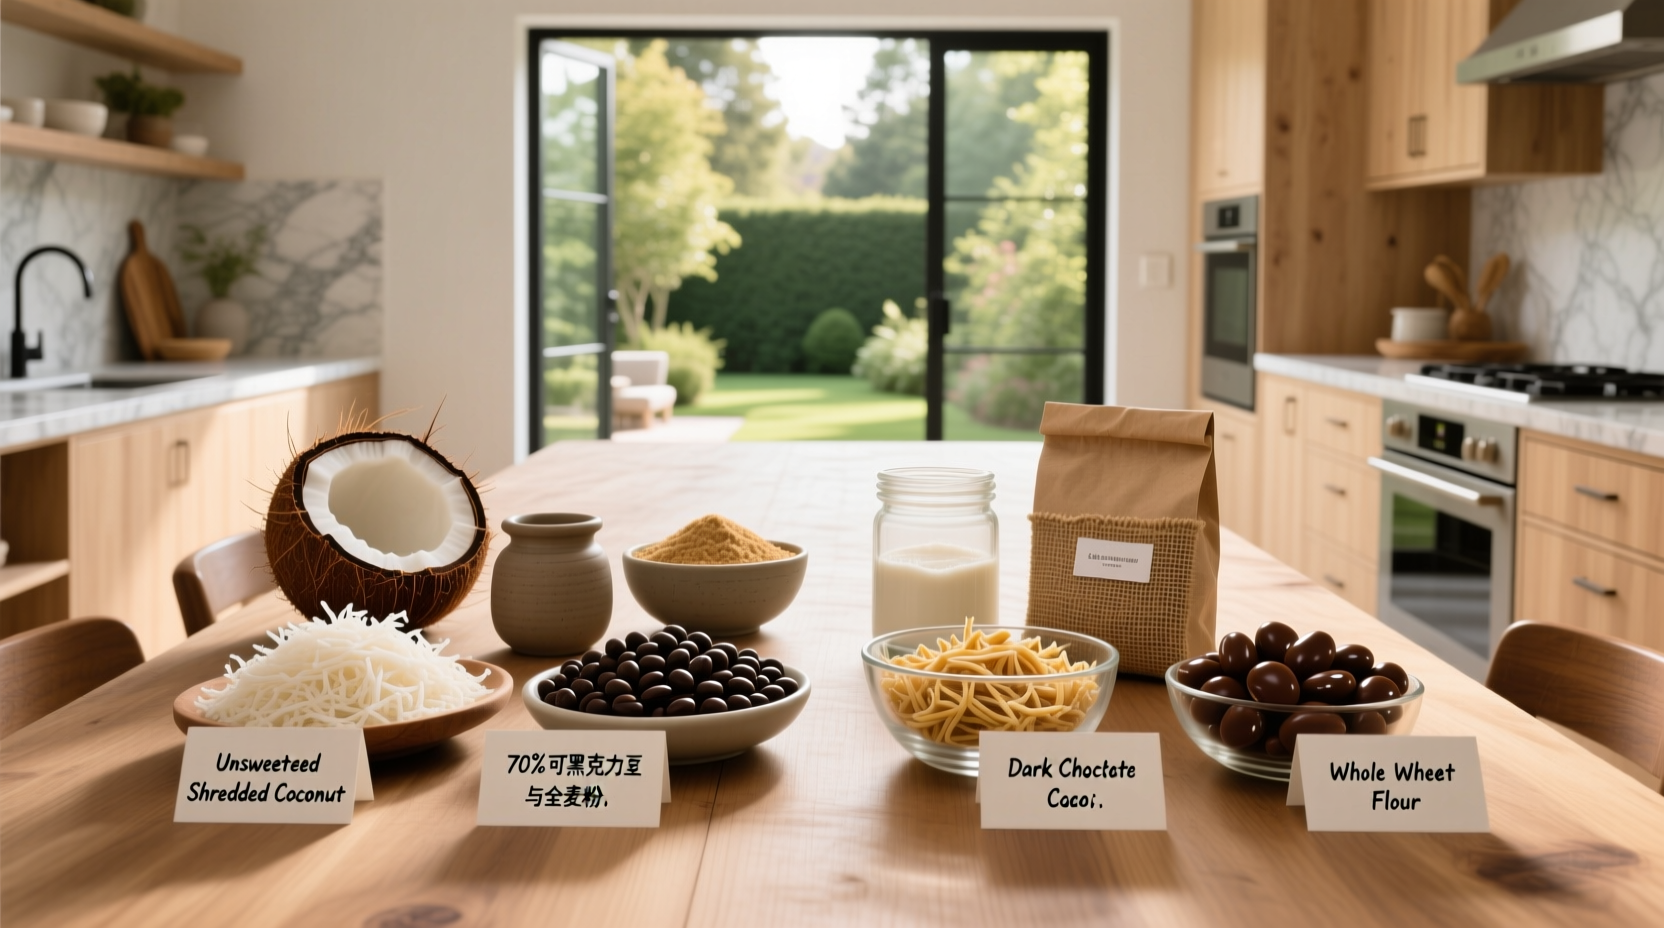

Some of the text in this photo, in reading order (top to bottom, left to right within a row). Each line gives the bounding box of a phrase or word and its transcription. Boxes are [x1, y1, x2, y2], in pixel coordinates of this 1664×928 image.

[216, 752, 322, 773] Unsweeteed
[1008, 756, 1053, 779] Dark
[1329, 760, 1456, 782] Whole Wheet
[186, 781, 347, 803] Shredded Coconut
[1371, 789, 1422, 811] Flour
